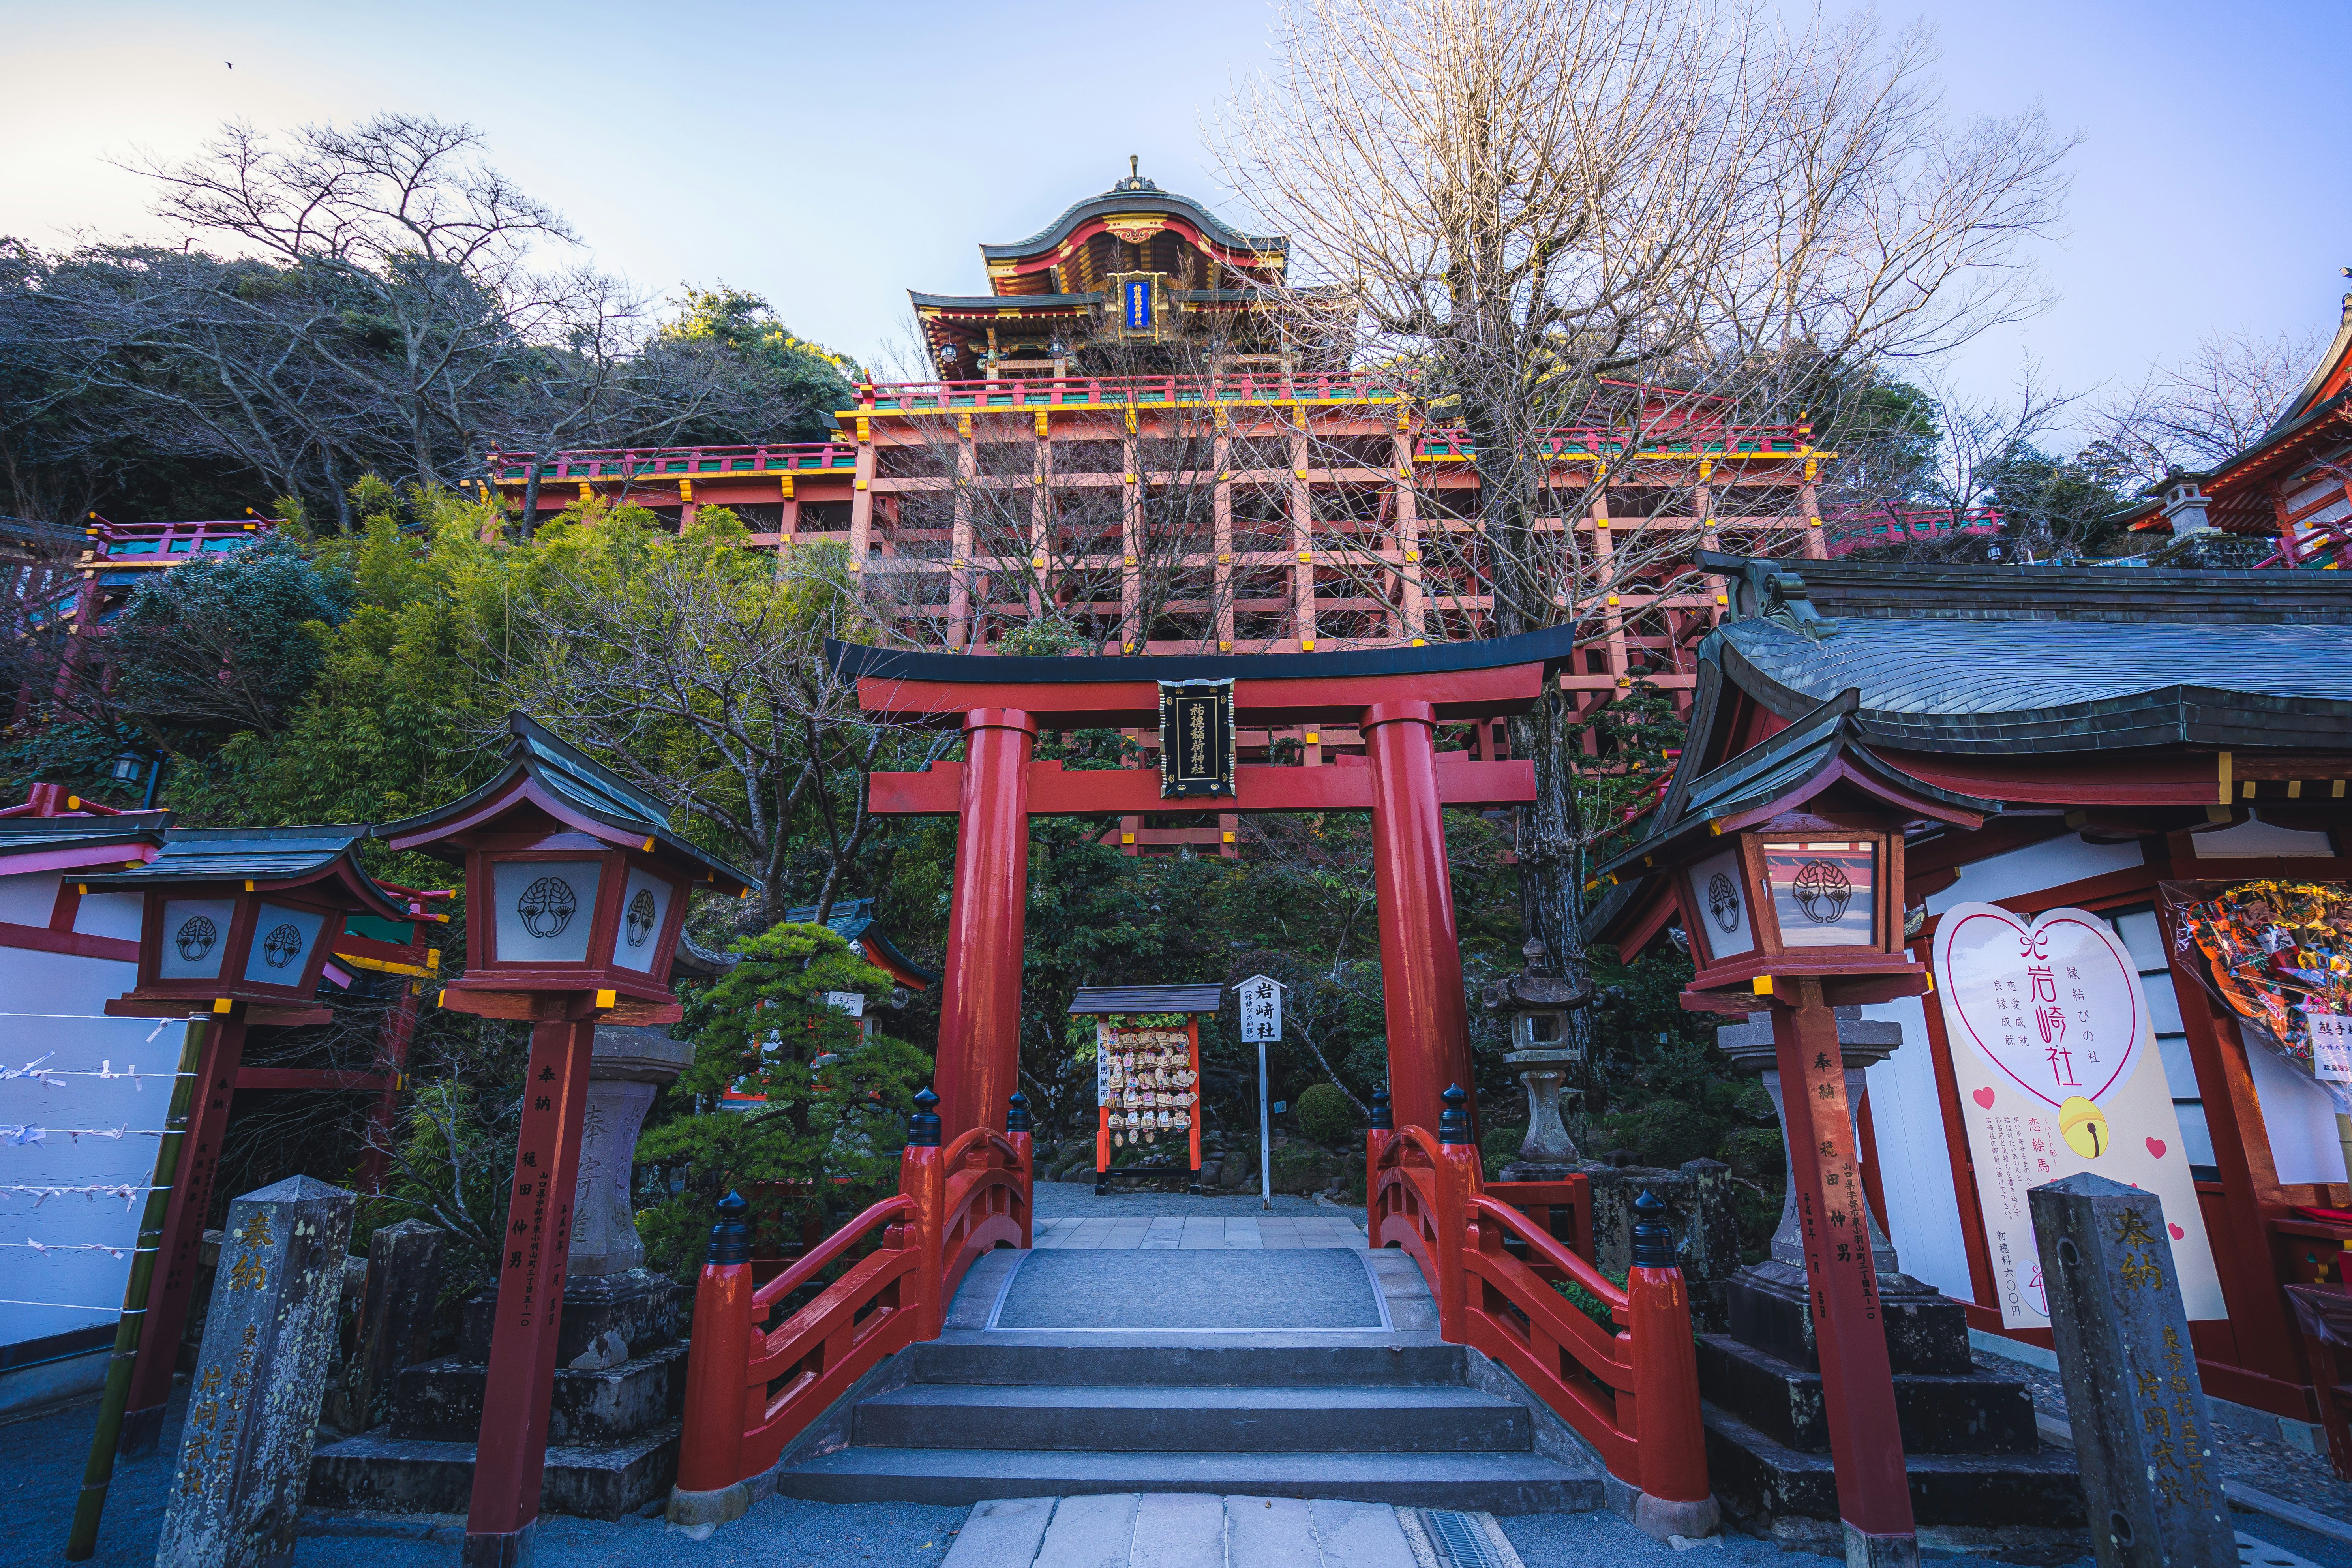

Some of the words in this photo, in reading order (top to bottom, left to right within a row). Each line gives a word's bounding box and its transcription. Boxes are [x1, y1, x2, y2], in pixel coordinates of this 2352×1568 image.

[1189, 703, 1205, 775] 祐徳稲荷神社
[832, 996, 856, 1005] くろまつ
[1994, 979, 2016, 1046] 良縁成就
[2007, 980, 2030, 1047] 恋愛成就
[2027, 964, 2082, 1086] 岩崎社
[2066, 966, 2101, 1063] 縁結びの社
[212, 1078, 229, 1110] 奉納
[535, 1065, 556, 1112] 奉納
[1099, 1030, 1109, 1098] 願絵馬納所
[1813, 1051, 1835, 1100] 奉納
[1986, 1116, 2013, 1220] 岩崎社の御前に掛けて下さい。
[1995, 1116, 2021, 1219] お名前と気持ちを書き込んで
[2003, 1116, 2022, 1182] 結ばれたいあの人と
[2028, 1117, 2050, 1174] 恋絵馬
[230, 1210, 274, 1292] 奉納
[555, 1203, 567, 1254] 平成四年
[1802, 1193, 1816, 1241] 平成四年
[1810, 1253, 1819, 1275] 一月
[1817, 1289, 1826, 1319] 吉日
[2115, 1207, 2163, 1292] 奉納
[551, 1263, 561, 1287] 一月
[548, 1297, 557, 1326] 吉日
